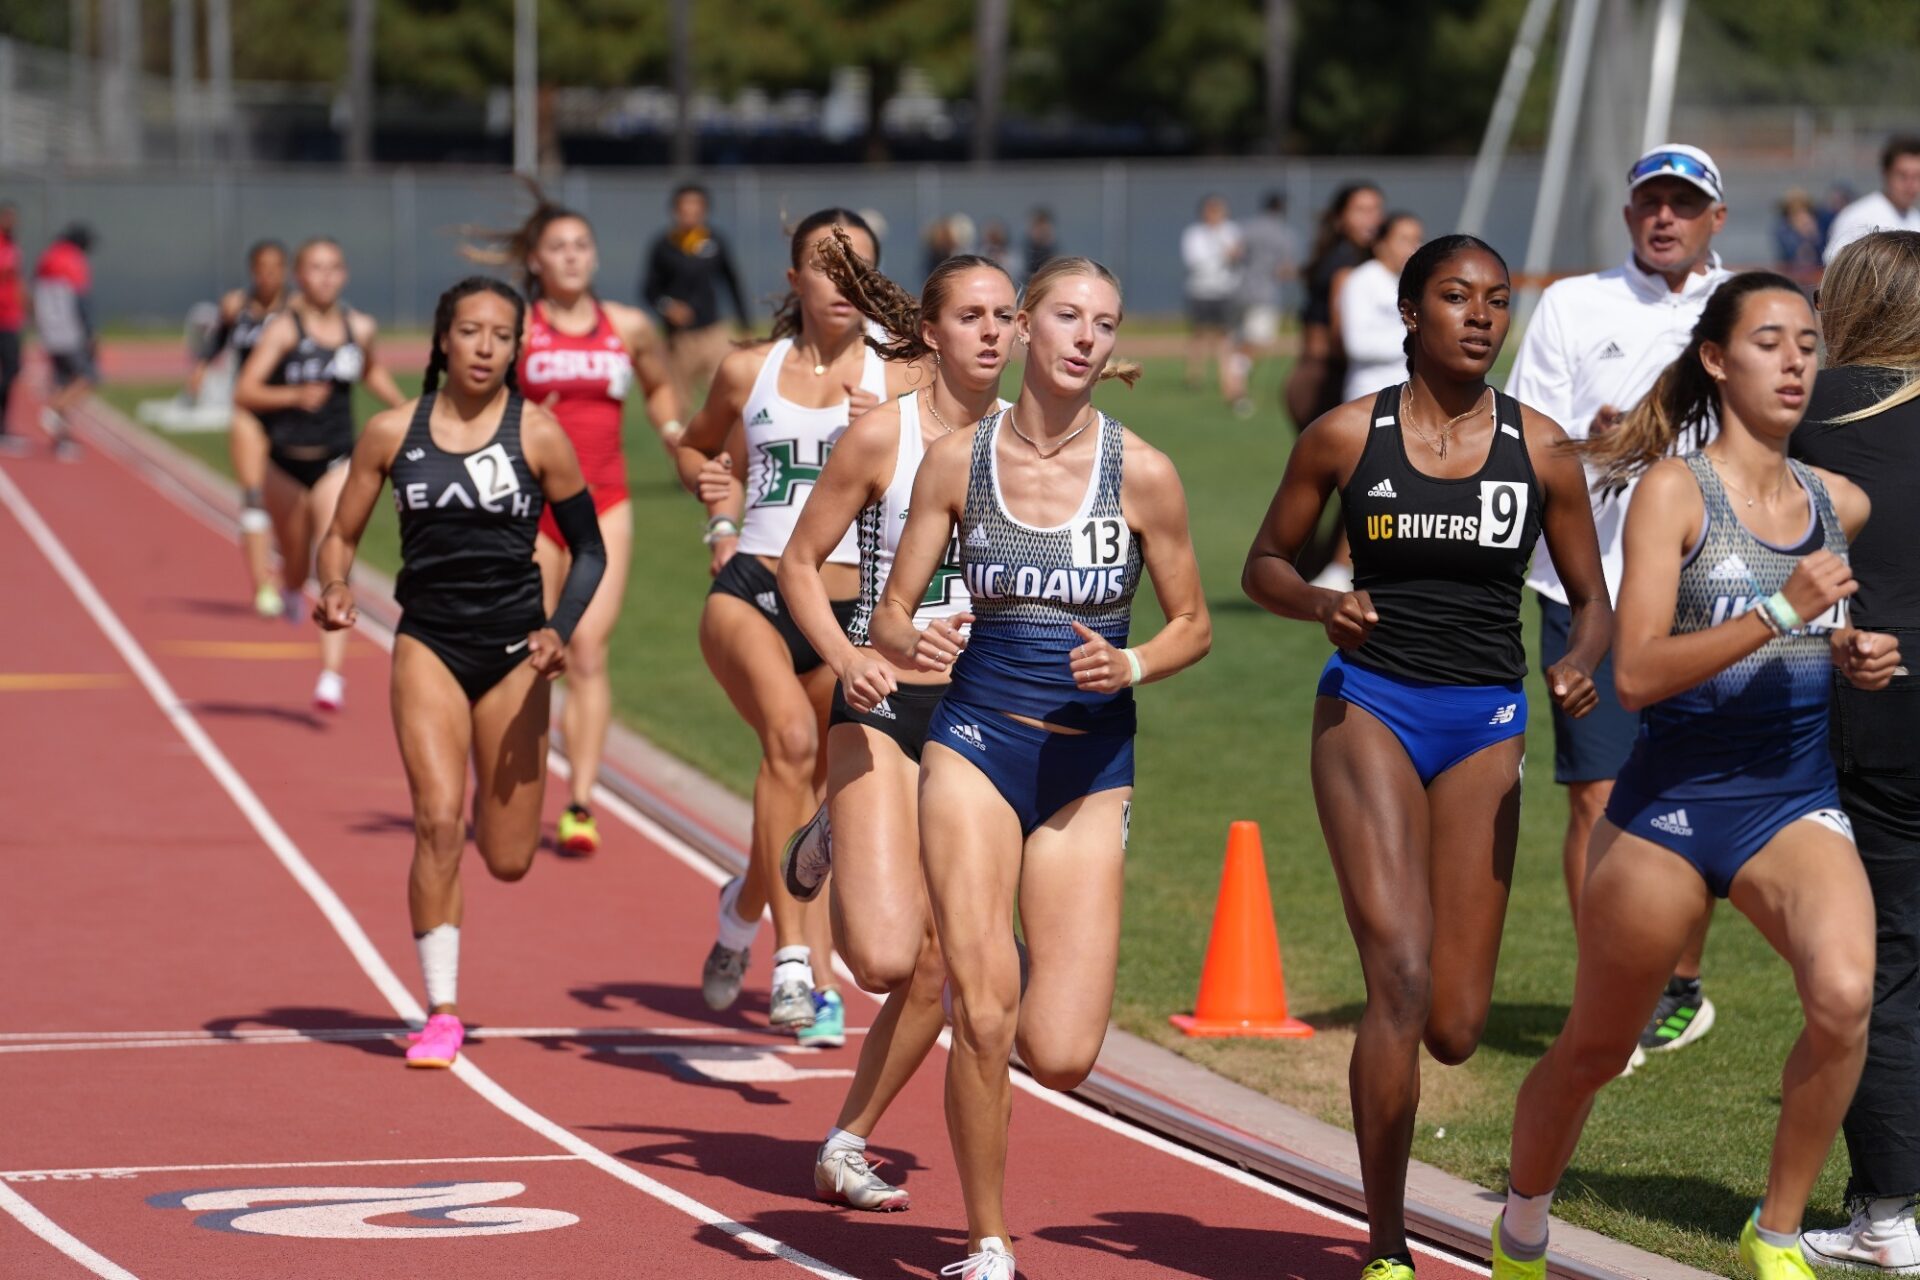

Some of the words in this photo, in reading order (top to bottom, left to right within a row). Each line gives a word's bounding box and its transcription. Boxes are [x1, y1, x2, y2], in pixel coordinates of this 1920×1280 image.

[476, 454, 510, 495] 2
[1367, 514, 1393, 541] UC
[1397, 513, 1479, 541] RIVERS
[1491, 484, 1518, 544] 9
[1081, 520, 1120, 565] 13
[966, 563, 1006, 599] UC
[1014, 566, 1125, 605] DAVIS
[949, 725, 987, 751] adidas
[1650, 817, 1693, 836] adidas
[160, 1180, 580, 1239] 2
